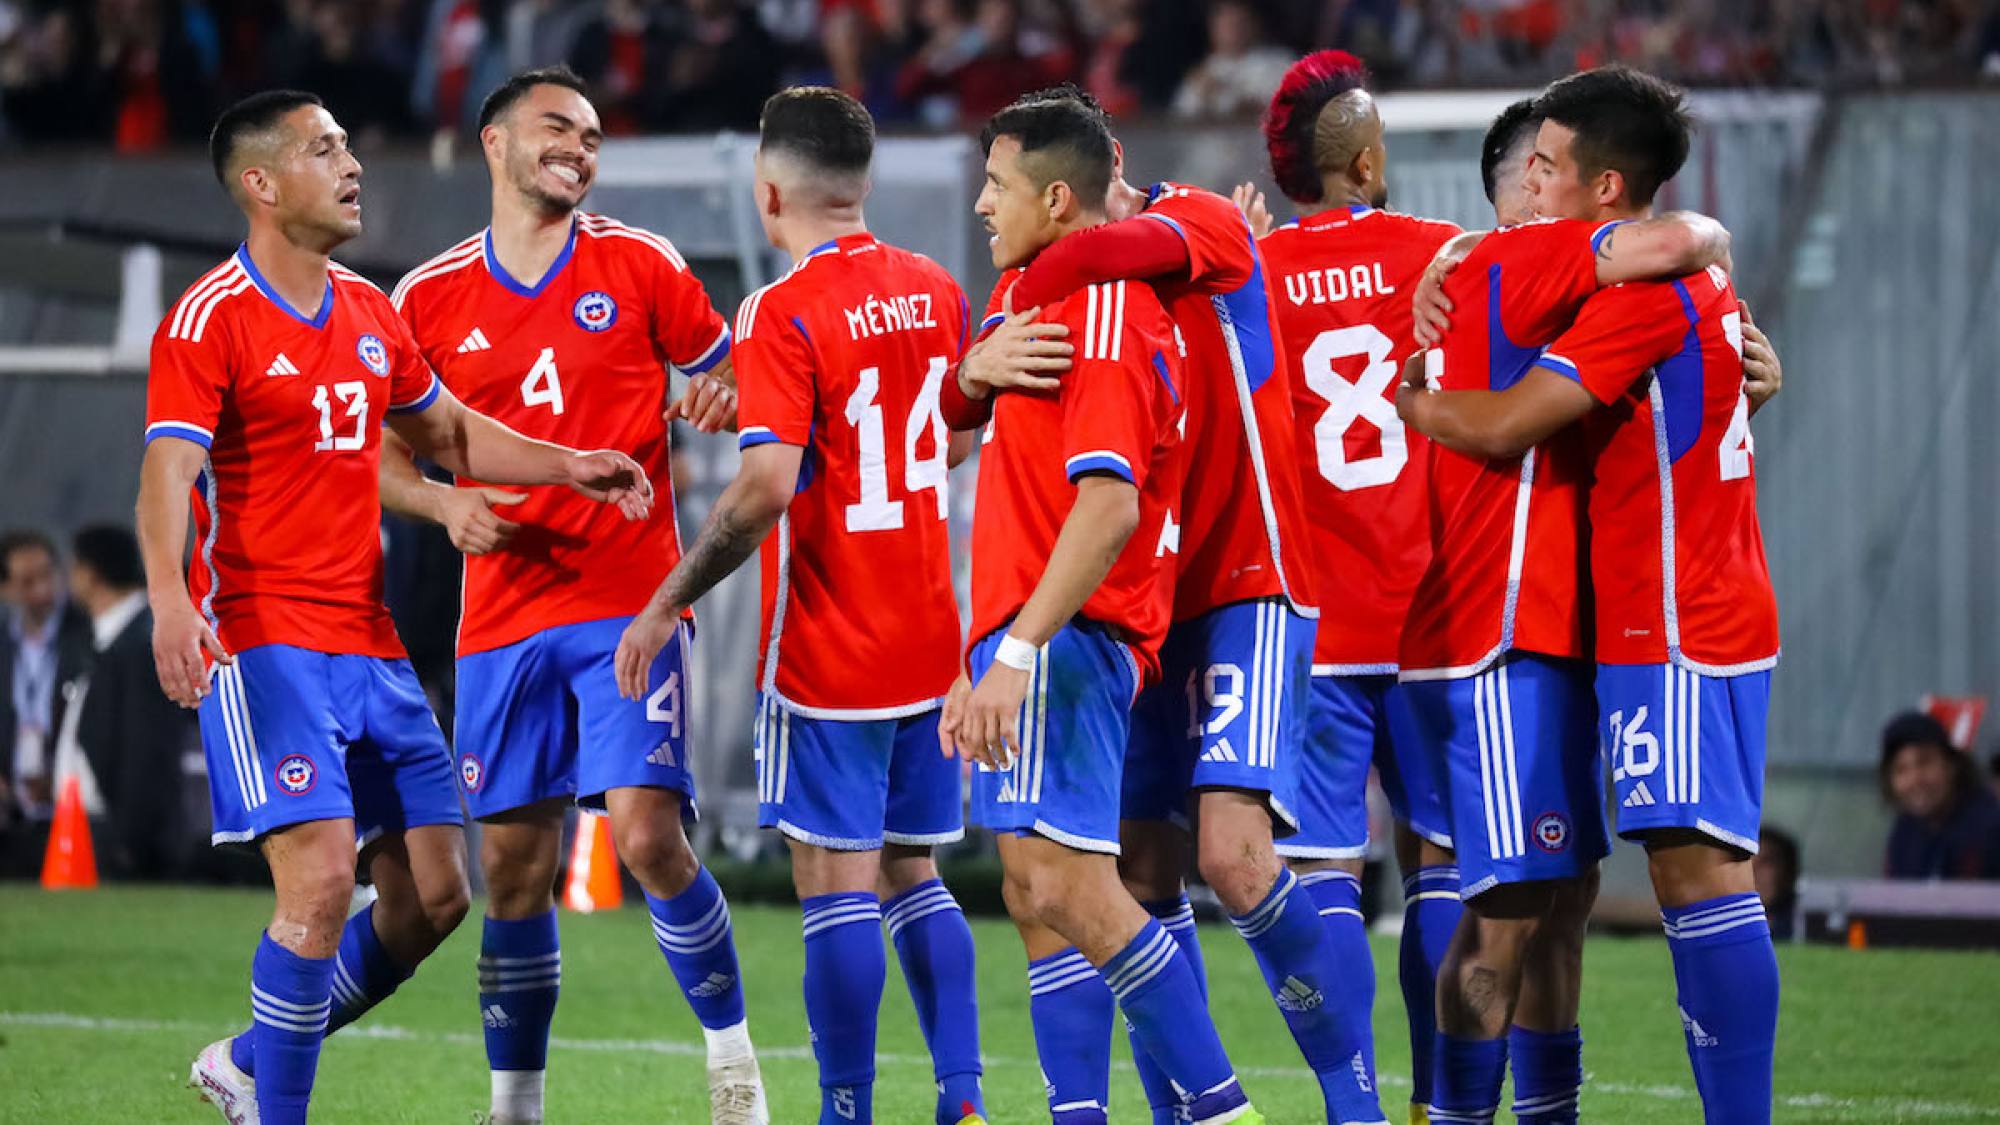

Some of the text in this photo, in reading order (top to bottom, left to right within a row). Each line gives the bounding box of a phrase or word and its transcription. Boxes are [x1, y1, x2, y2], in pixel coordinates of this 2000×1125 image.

[843, 293, 938, 341] MÉNDEZ
[1284, 262, 1396, 306] VIDAL
[311, 380, 369, 453] 13
[520, 346, 564, 415] 4
[1302, 323, 1408, 492] 8
[844, 356, 949, 532] 14
[646, 671, 681, 739] 4
[1185, 663, 1245, 740] 19
[1609, 704, 1661, 784] 26
